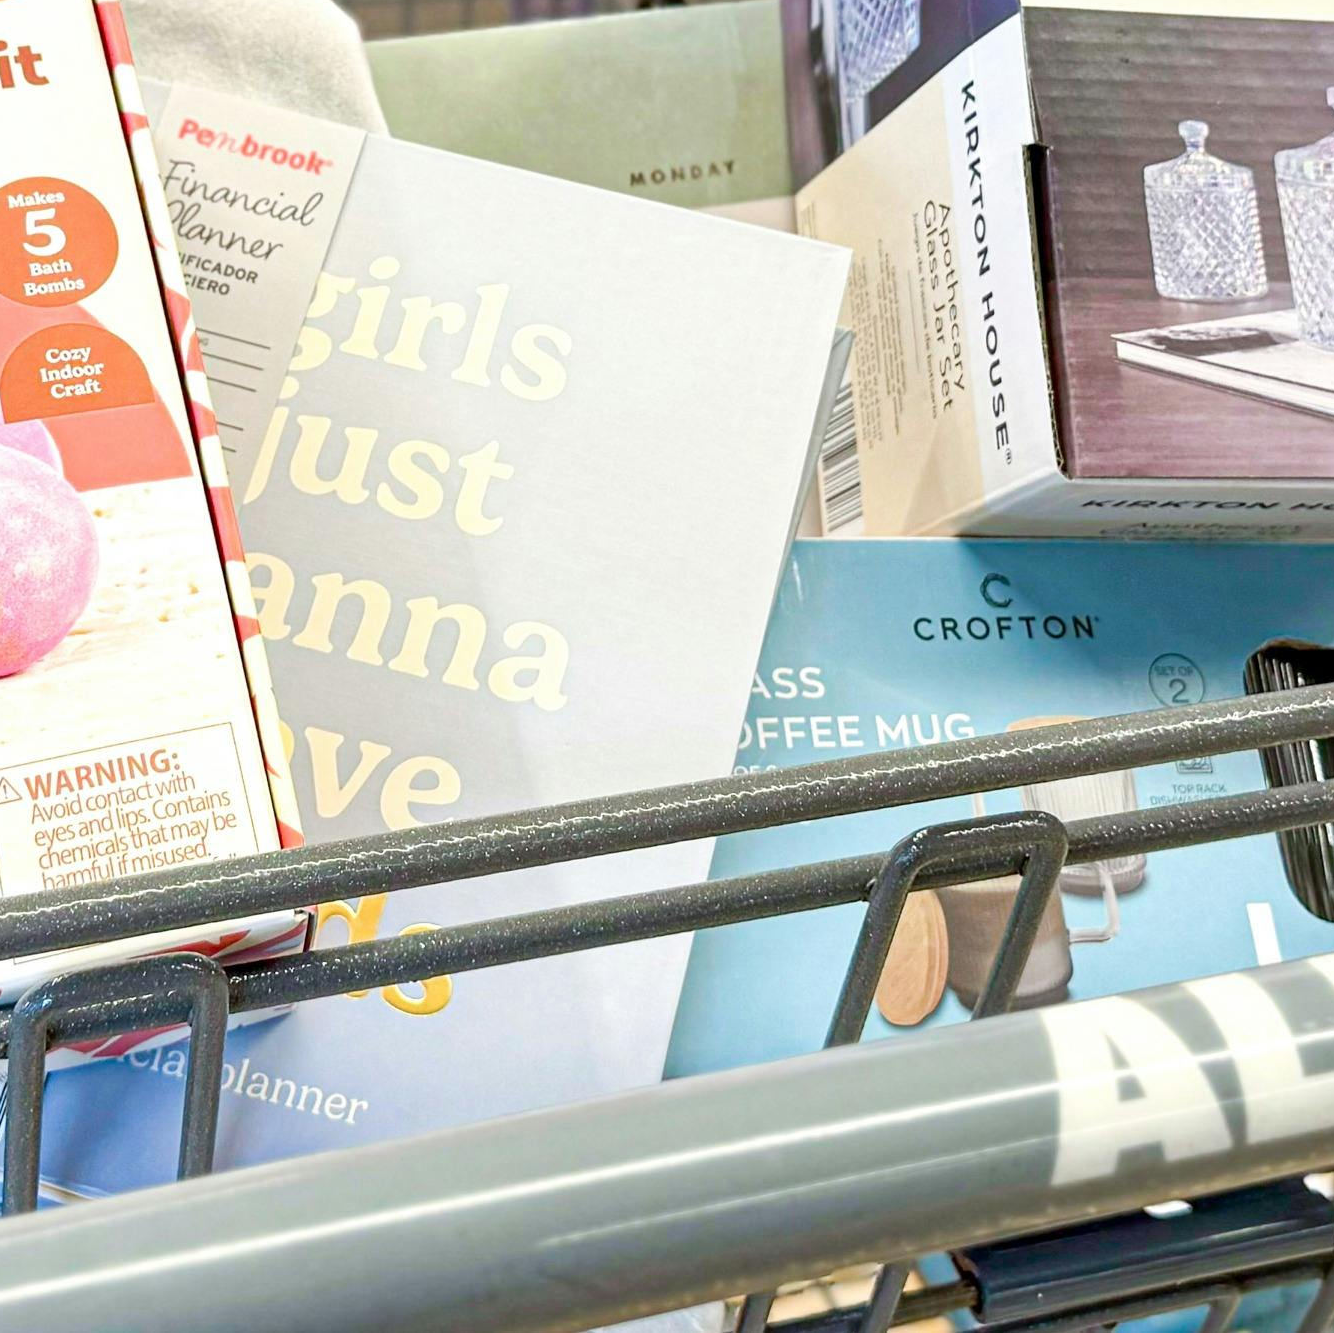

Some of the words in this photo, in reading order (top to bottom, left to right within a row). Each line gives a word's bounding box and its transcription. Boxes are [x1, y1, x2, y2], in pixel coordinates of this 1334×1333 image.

[177, 117, 327, 176] Penbrook
[163, 158, 325, 227] Financial
[629, 159, 736, 187] MONDAY
[960, 80, 991, 278] KIRKTON
[7, 190, 67, 210] Makes
[22, 207, 68, 257] 5
[923, 199, 940, 292] Glass
[23, 276, 86, 298] Bombs
[28, 258, 73, 278] Bath
[178, 250, 260, 285] IFICADOR
[937, 202, 965, 392] Apothecary
[932, 303, 947, 345] Jar
[39, 362, 105, 384] Indoor
[45, 345, 92, 365] Cozy
[50, 379, 103, 401] Craft
[938, 356, 955, 411] Set
[241, 375, 516, 538] just
[1080, 497, 1281, 512] KIRKTON
[912, 614, 1095, 642] CROFTON
[1168, 677, 1191, 705] 2
[874, 712, 976, 747] MUG
[23, 748, 181, 801] WARNING:
[1171, 783, 1194, 795] TOP
[1196, 782, 1228, 794] RACK
[30, 794, 83, 825] Avoid
[85, 783, 154, 813] contact
[155, 770, 196, 798] with
[34, 823, 77, 849] eyes
[78, 808, 115, 837] and
[116, 806, 152, 832] lips.
[152, 788, 232, 820] Contains
[38, 831, 130, 870] chemicals
[130, 821, 169, 850] that
[170, 816, 211, 844] may
[213, 810, 238, 832] be
[41, 856, 115, 891] harmful
[117, 854, 132, 876] if
[132, 838, 212, 871] misused.
